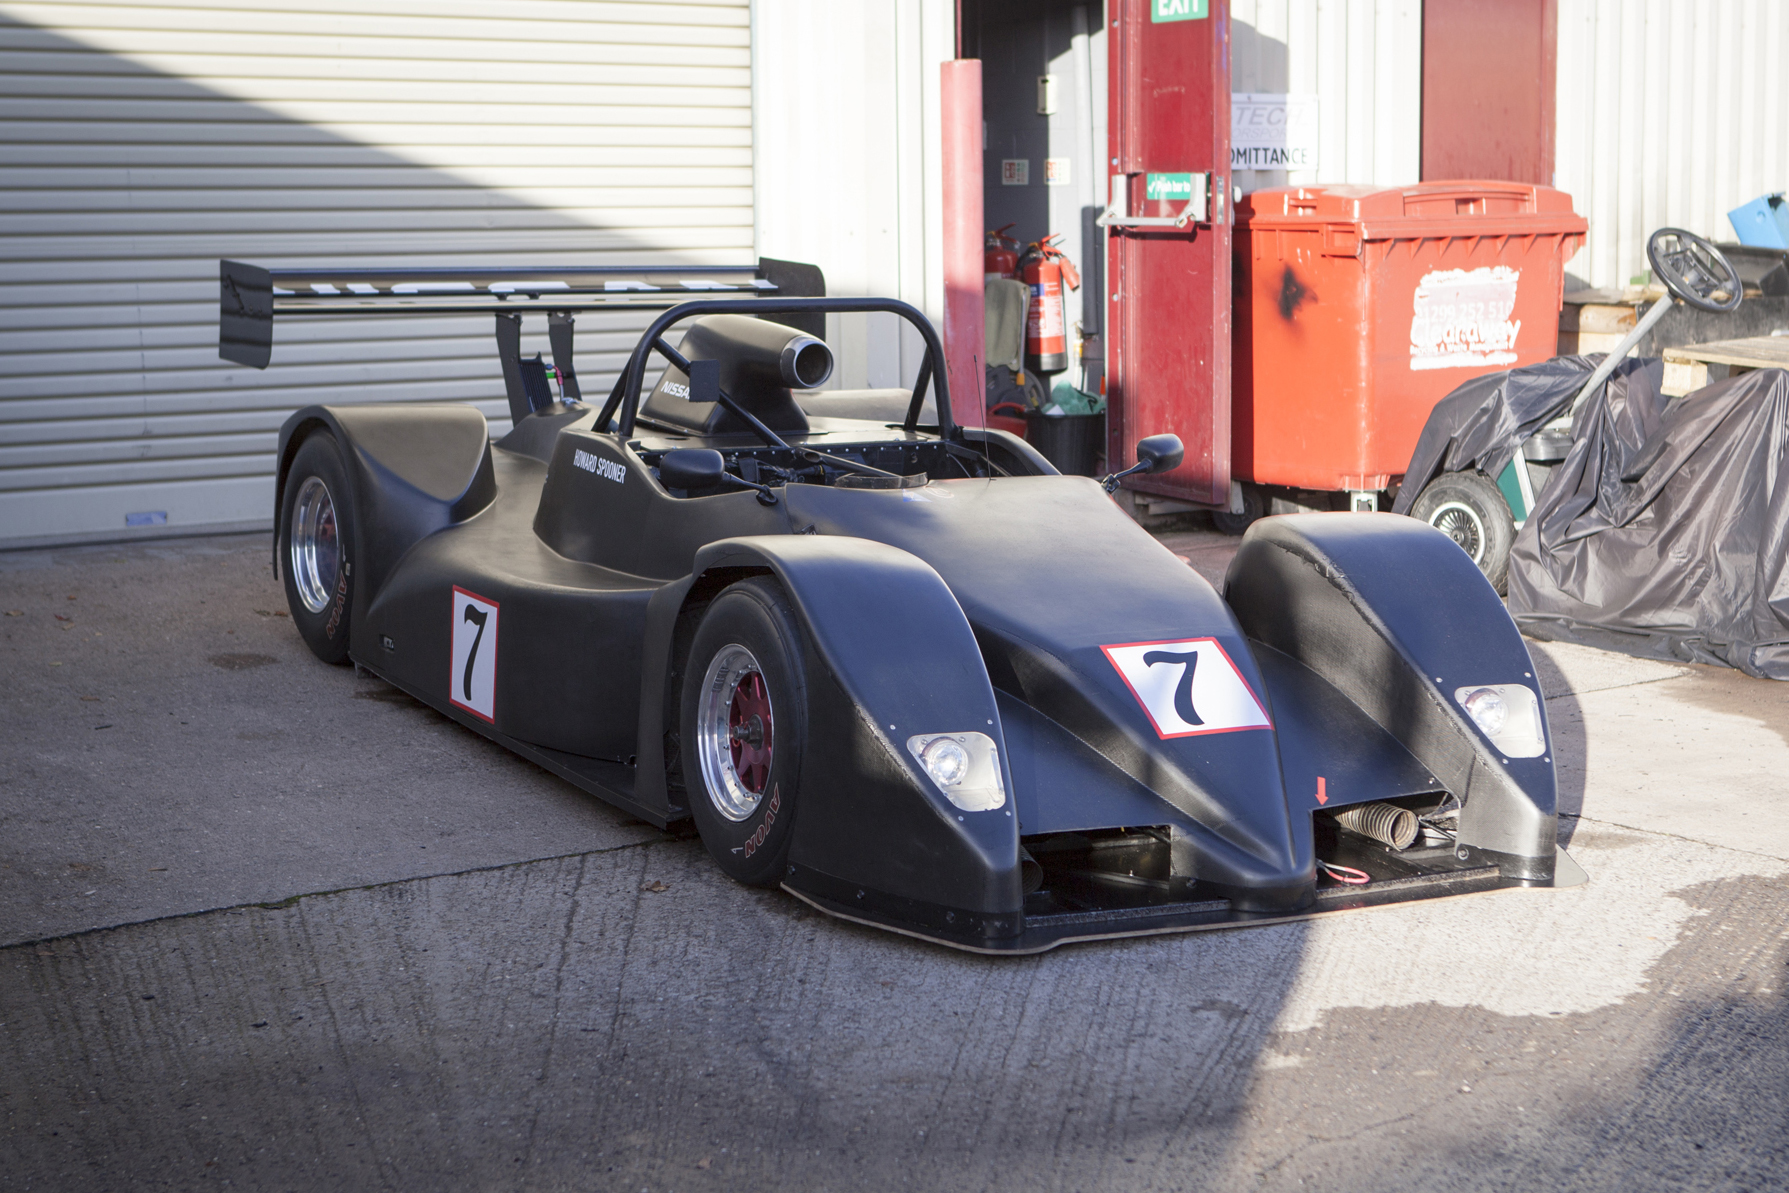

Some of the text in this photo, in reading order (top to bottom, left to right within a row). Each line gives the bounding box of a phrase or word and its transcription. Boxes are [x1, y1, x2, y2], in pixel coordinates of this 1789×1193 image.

[660, 380, 690, 400] NISSA
[573, 448, 627, 484] HOWARD SPOONER
[326, 569, 347, 640] AVON
[464, 603, 488, 701] 7
[1143, 650, 1206, 726] 7
[745, 781, 780, 858] AVON
